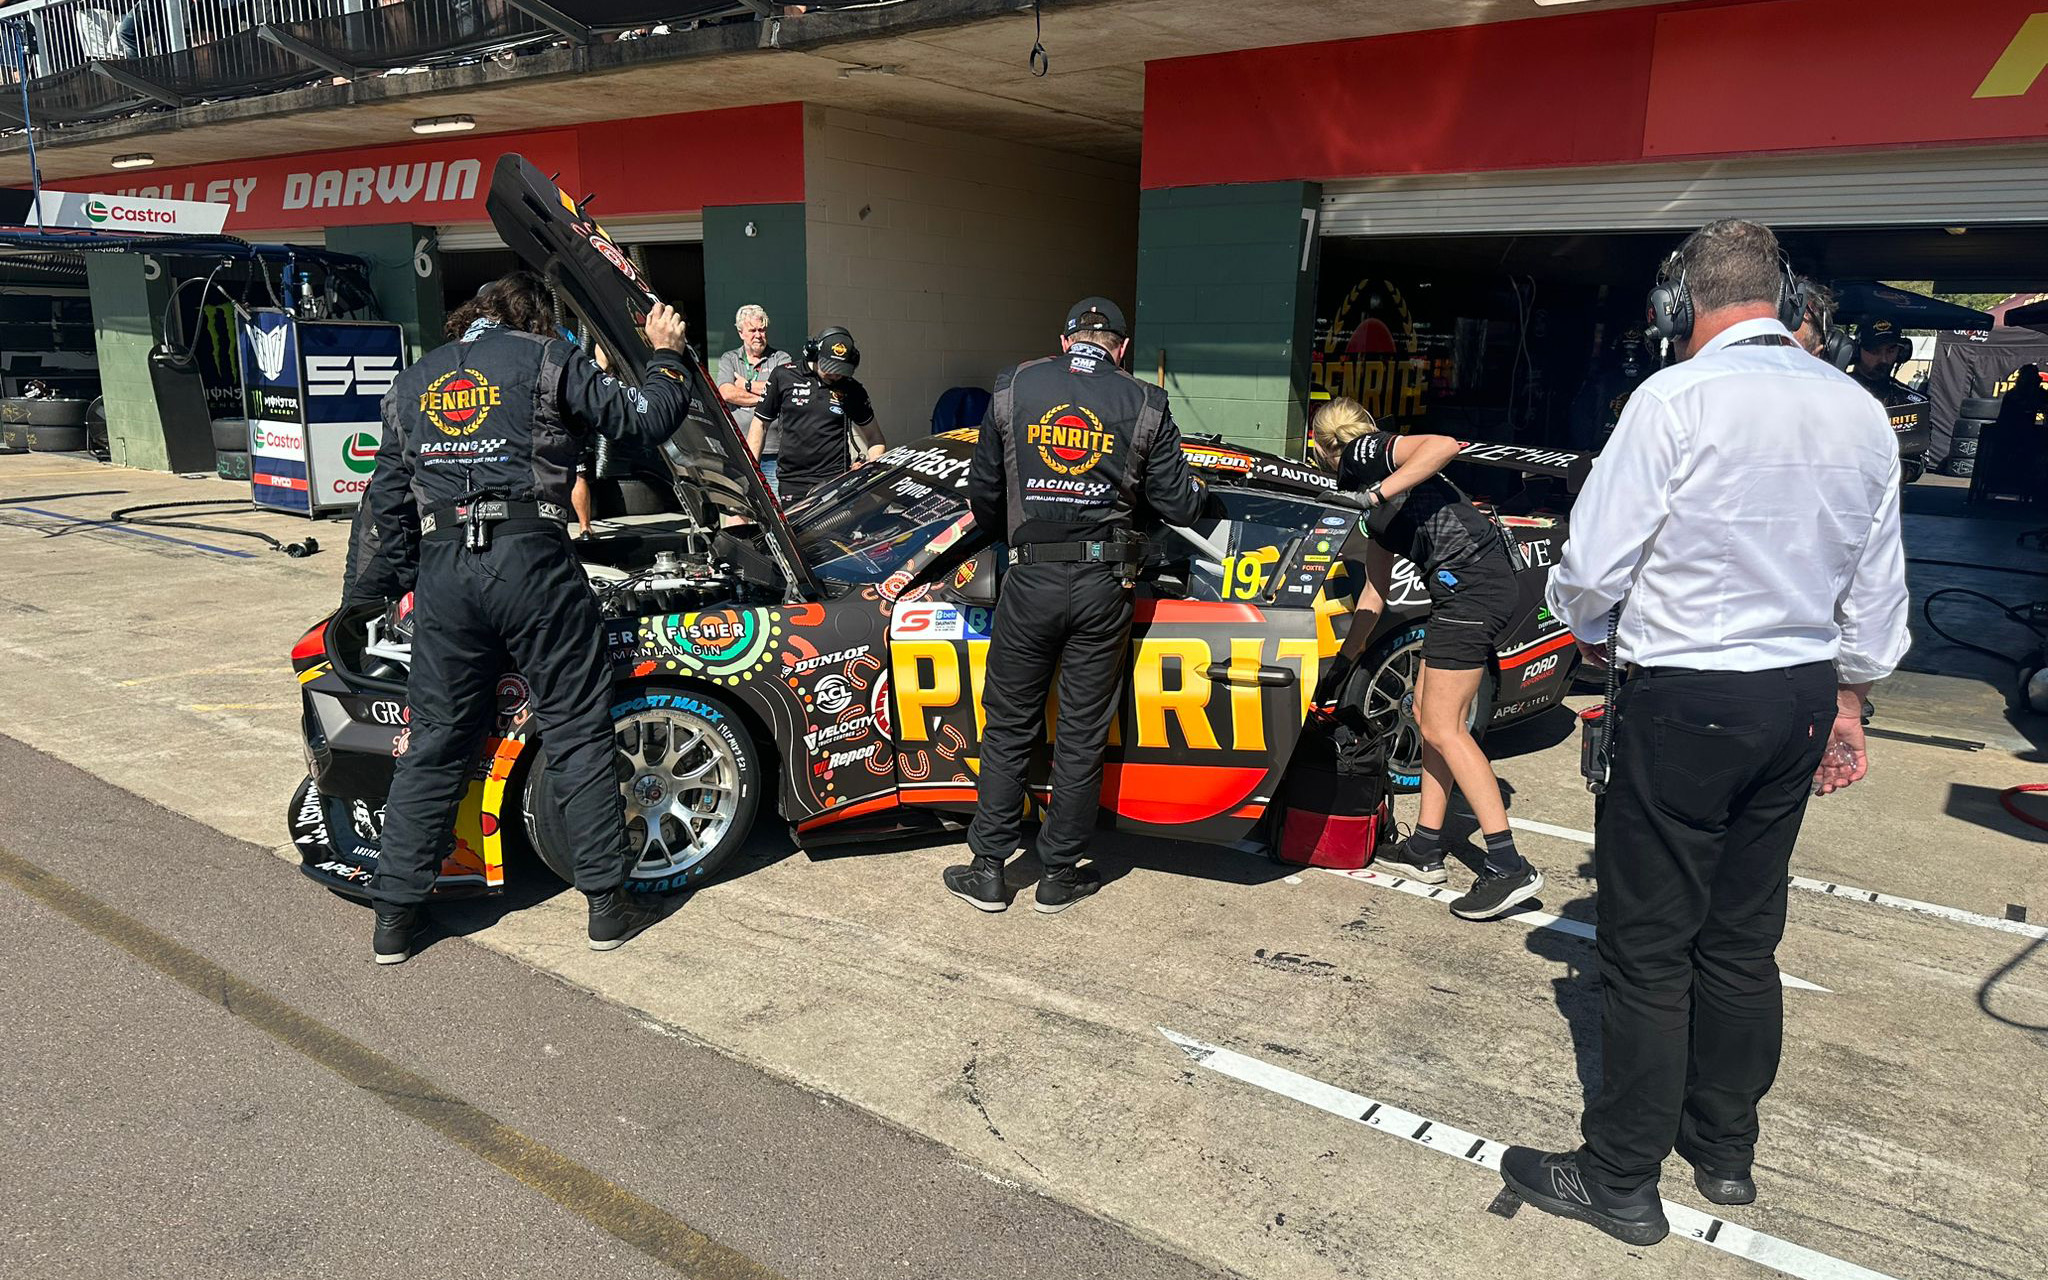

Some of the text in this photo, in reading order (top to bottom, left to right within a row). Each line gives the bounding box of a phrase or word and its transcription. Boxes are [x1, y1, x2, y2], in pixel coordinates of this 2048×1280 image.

[282, 158, 481, 211] DARWIN
[111, 206, 177, 224] Castrol
[414, 236, 434, 278] 6
[1071, 357, 1096, 367] OMP
[305, 356, 399, 396] 55
[420, 385, 501, 412] PENRITE
[266, 432, 303, 450] Castrol
[421, 440, 479, 453] RACING
[1027, 424, 1115, 454] PENRITE
[1183, 452, 1246, 467] nap-on
[889, 476, 932, 498] Payne
[1026, 478, 1086, 491] RACING
[1221, 556, 1262, 599] 19
[666, 623, 746, 640] FISHER
[692, 644, 721, 656] GIN
[794, 644, 870, 673] DUNLOP
[1522, 654, 1558, 682] FORD
[816, 686, 852, 705] ACL
[671, 695, 725, 725] MAXX
[1493, 702, 1525, 719] APEX
[818, 714, 876, 741] VELOCITY
[828, 745, 876, 770] Repco
[314, 861, 367, 881] APEX
[1691, 1228, 1704, 1238] 3
